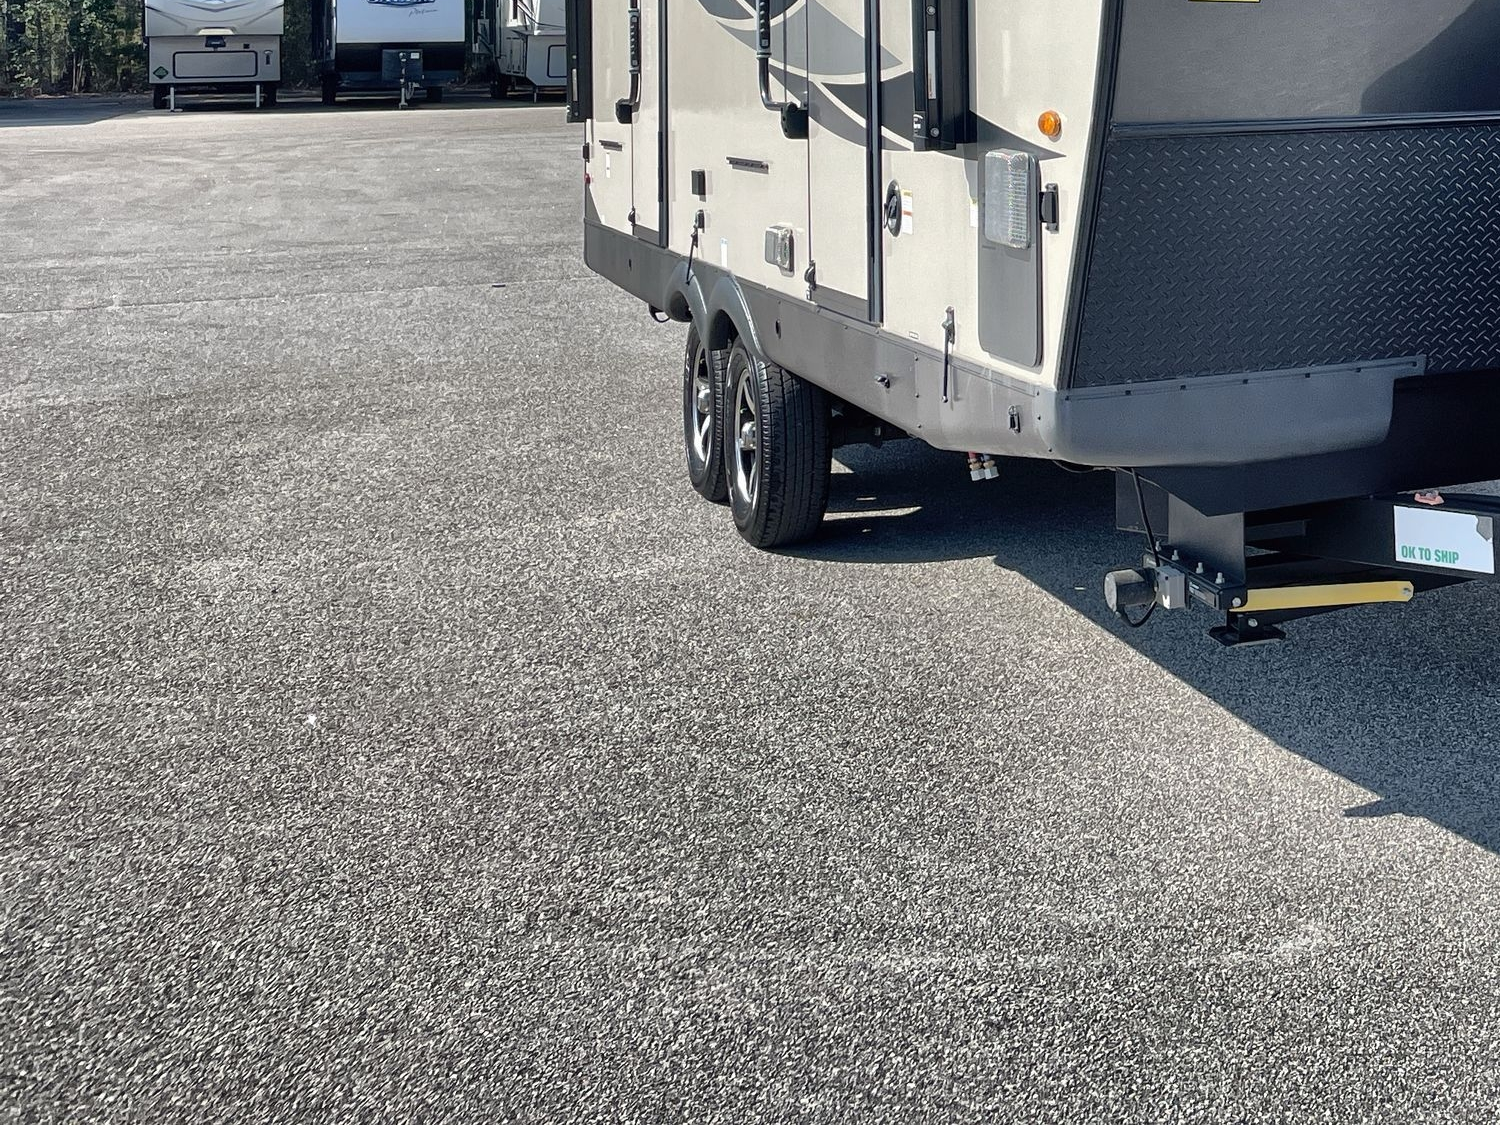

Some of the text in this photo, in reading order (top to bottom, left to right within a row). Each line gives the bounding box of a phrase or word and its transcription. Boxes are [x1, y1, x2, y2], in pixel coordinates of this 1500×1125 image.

[1400, 545, 1460, 564] OK TO SHIP
